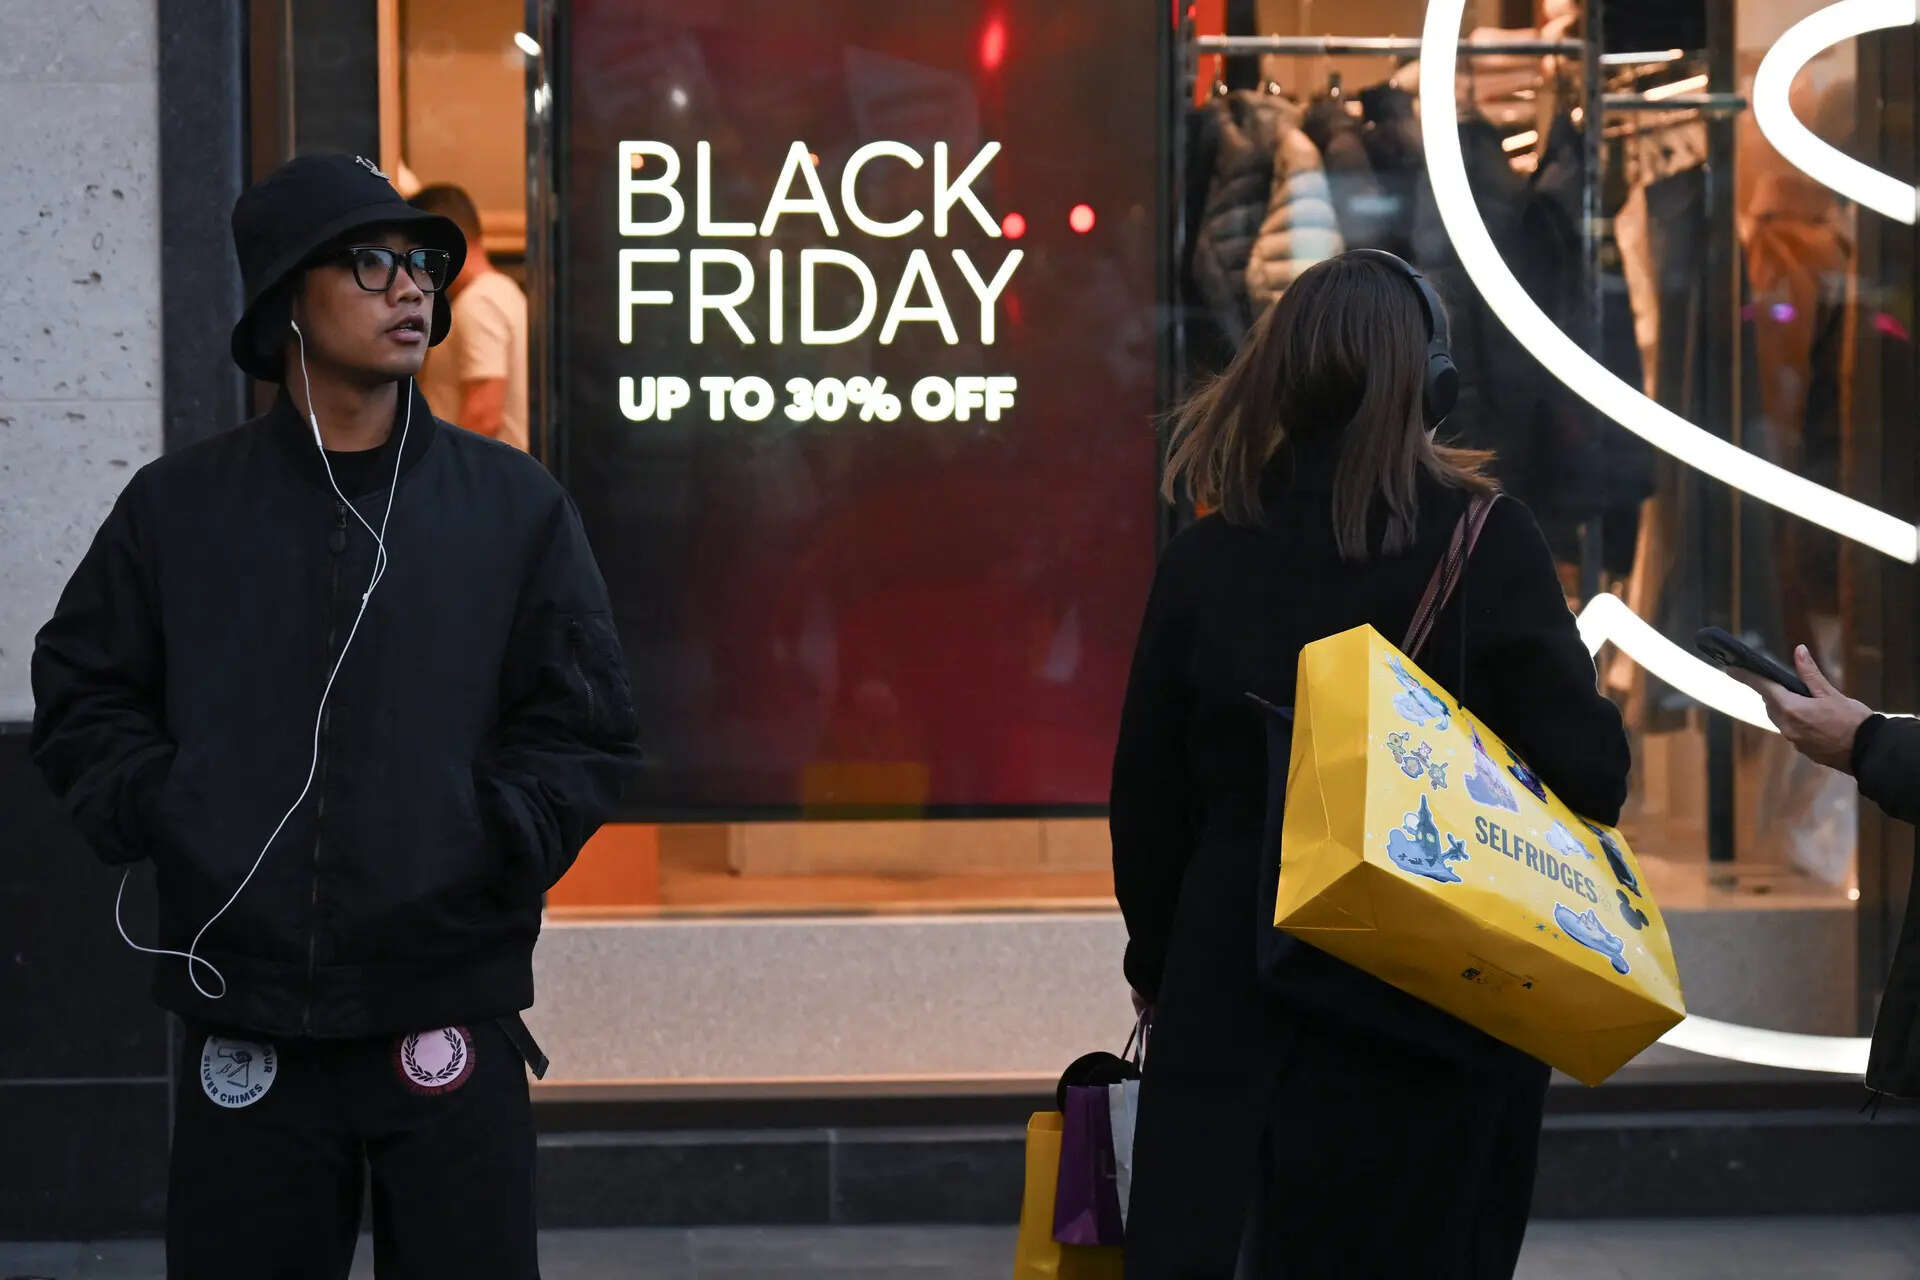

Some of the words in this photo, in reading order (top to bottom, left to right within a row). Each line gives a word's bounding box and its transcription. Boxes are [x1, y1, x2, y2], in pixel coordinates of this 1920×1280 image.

[619, 141, 1001, 237] BLACK
[619, 249, 1023, 344] FRIDAY
[619, 377, 690, 421] UP
[700, 376, 775, 421] TO
[784, 376, 901, 422] 30%
[911, 376, 1017, 421] OFF
[1475, 816, 1598, 903] SELFRIDGES
[204, 1055, 218, 1096] SILVER
[220, 1084, 263, 1104] CHIMES
